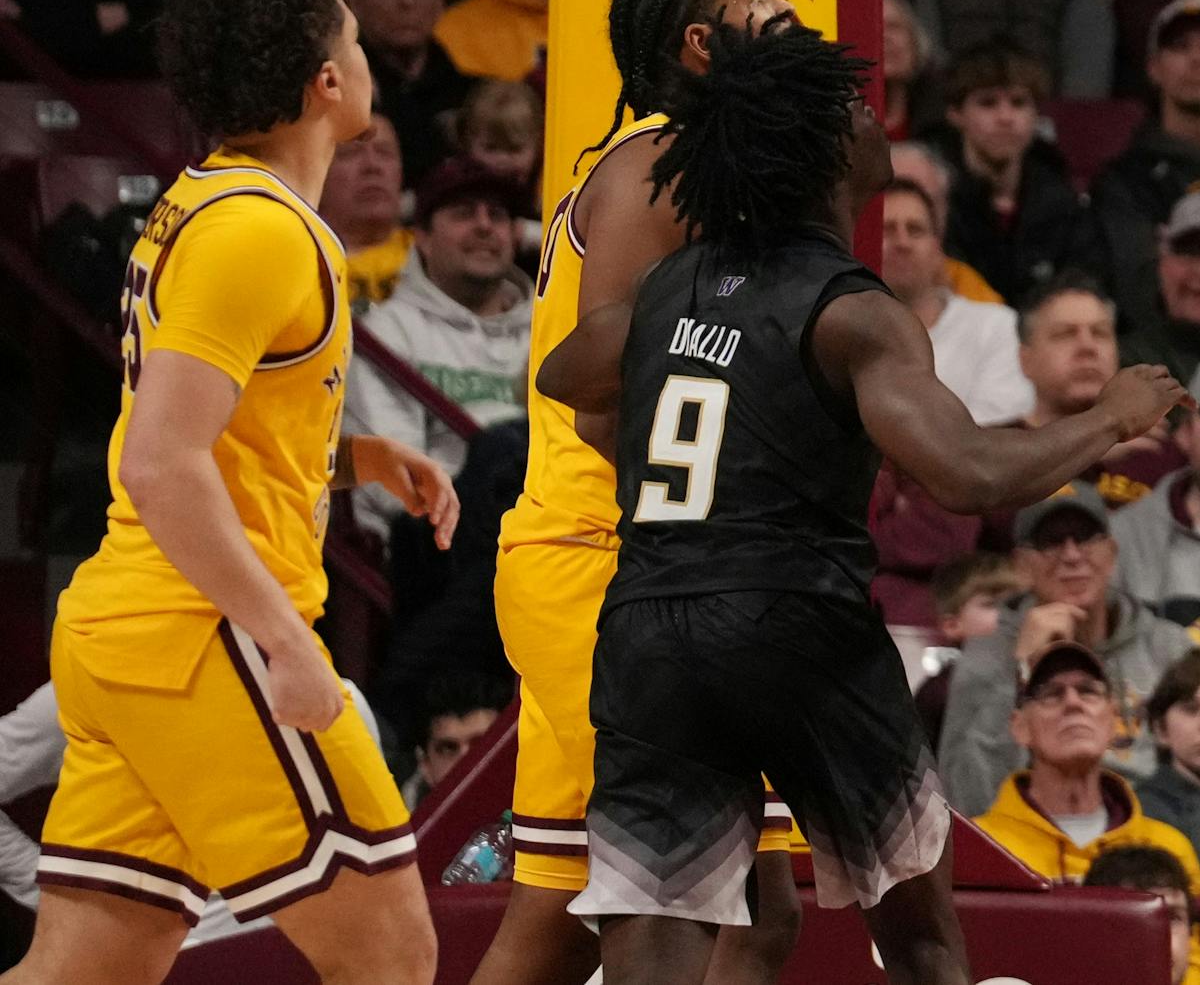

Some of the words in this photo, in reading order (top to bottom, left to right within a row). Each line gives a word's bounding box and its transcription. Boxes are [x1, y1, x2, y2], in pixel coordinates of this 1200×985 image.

[716, 276, 746, 297] W
[669, 317, 742, 367] DIALLO
[632, 374, 730, 522] 9
